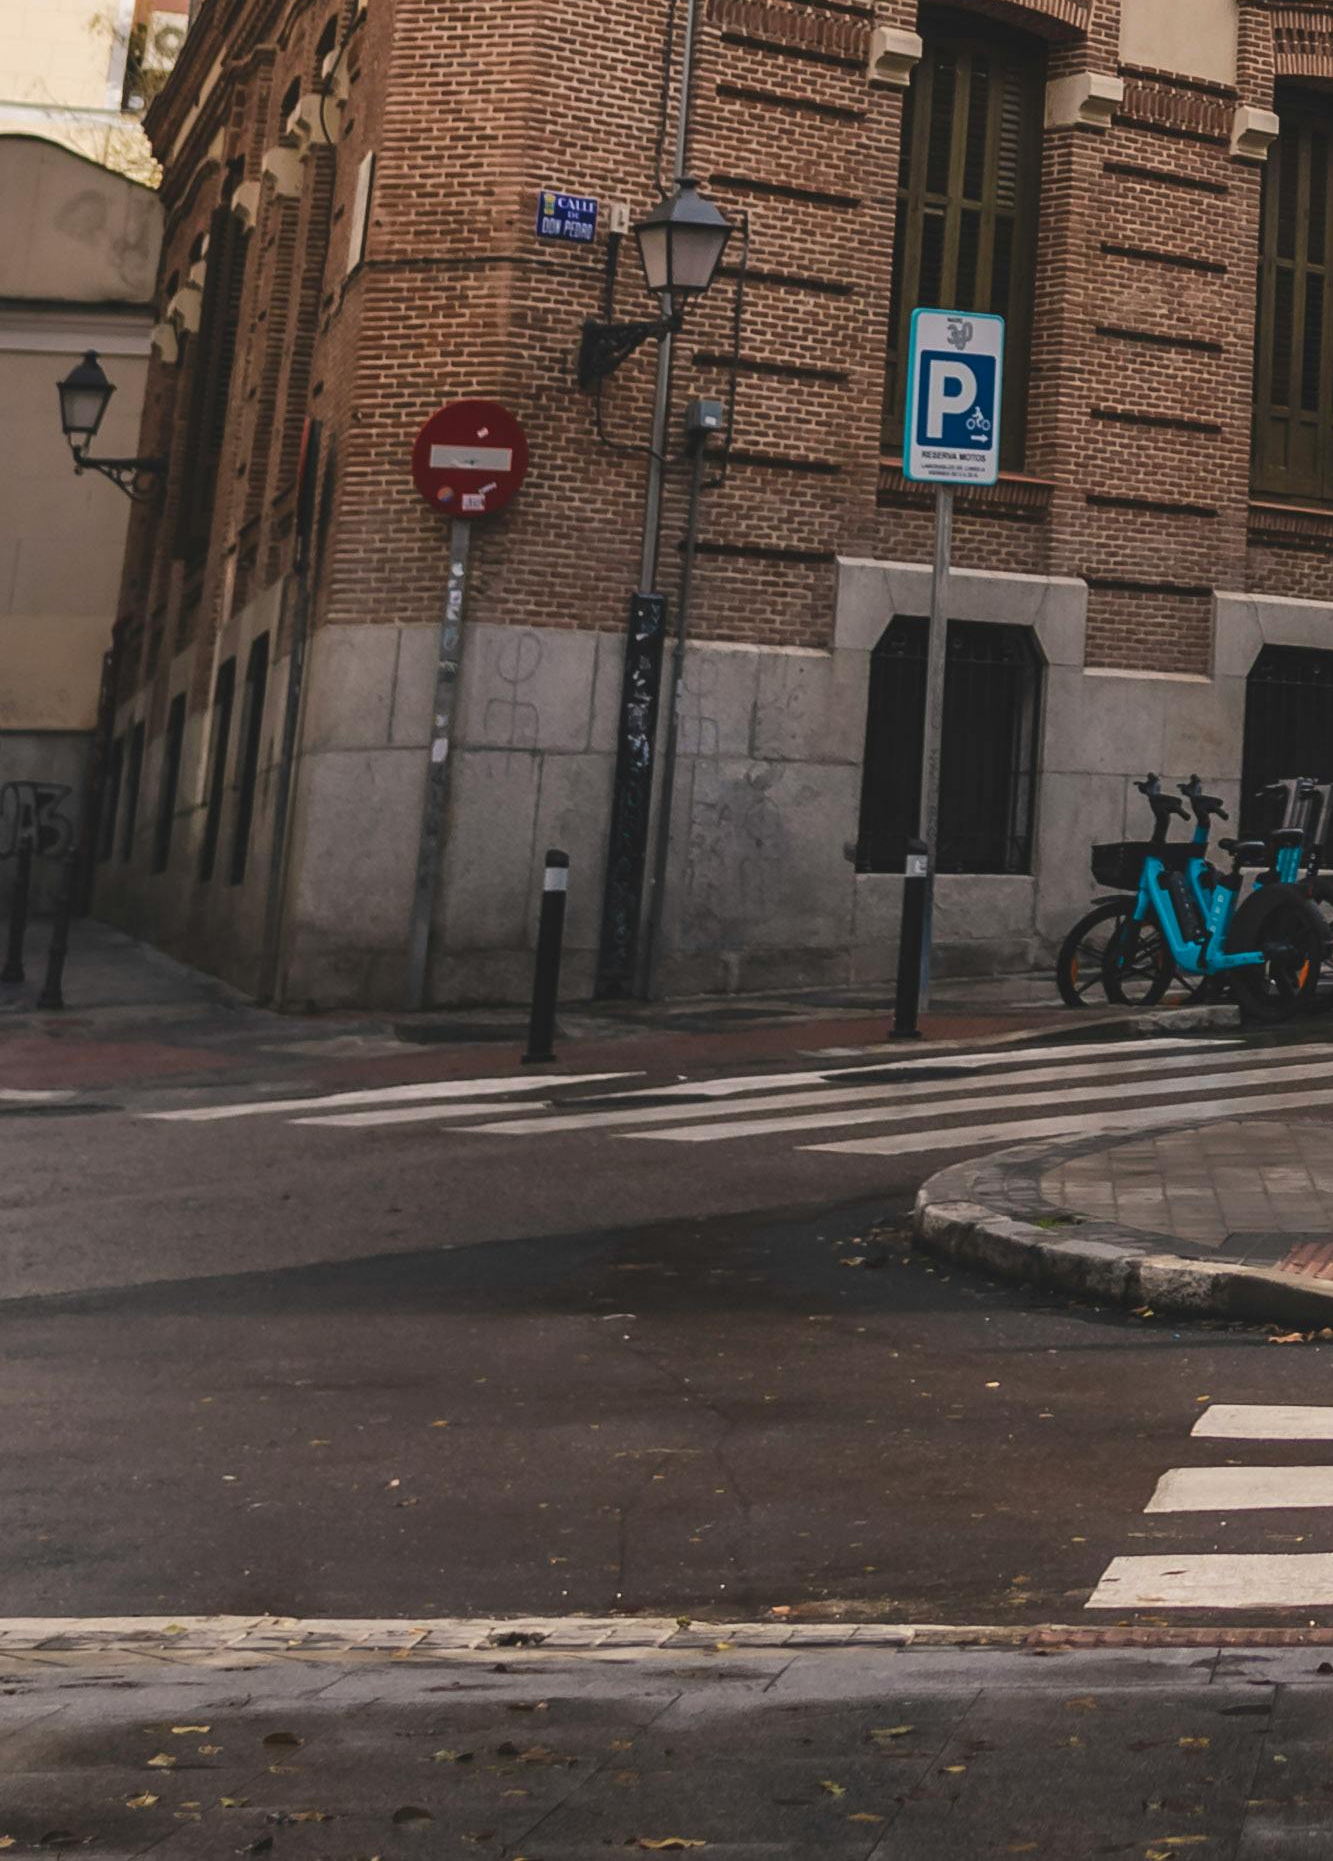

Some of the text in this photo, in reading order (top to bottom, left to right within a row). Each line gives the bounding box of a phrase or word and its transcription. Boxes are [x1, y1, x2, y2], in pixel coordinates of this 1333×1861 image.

[541, 216, 593, 240] DON PEDRO
[926, 359, 977, 438] P
